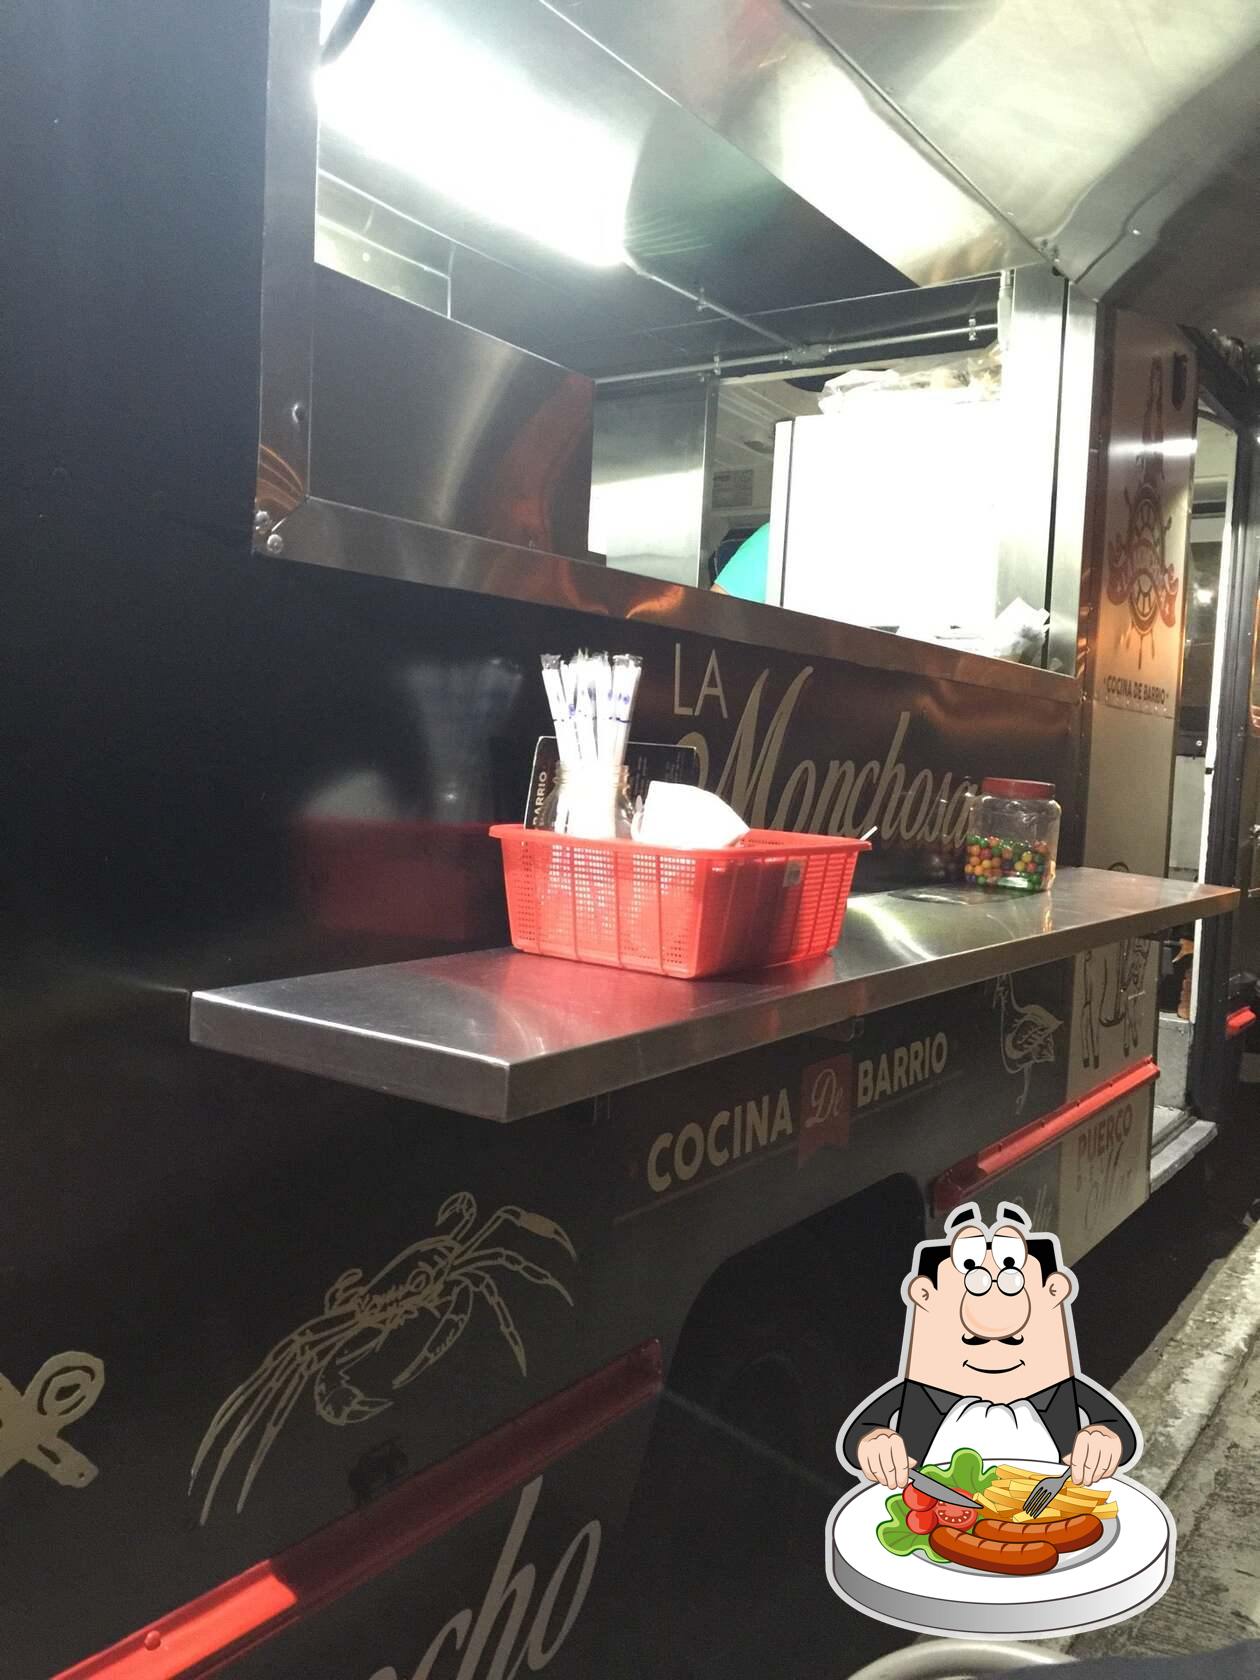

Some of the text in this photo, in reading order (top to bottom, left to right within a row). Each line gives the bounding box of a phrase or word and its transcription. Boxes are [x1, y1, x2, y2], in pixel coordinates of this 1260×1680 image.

[672, 641, 728, 718] LA
[1107, 675, 1165, 705] COCINA DE BARRIO
[676, 664, 979, 849] Monchosa
[648, 1089, 793, 1192] COCINA
[858, 1031, 948, 1107] BARRIO
[1077, 1103, 1133, 1171] PUERCO
[371, 1475, 602, 1680] cho
